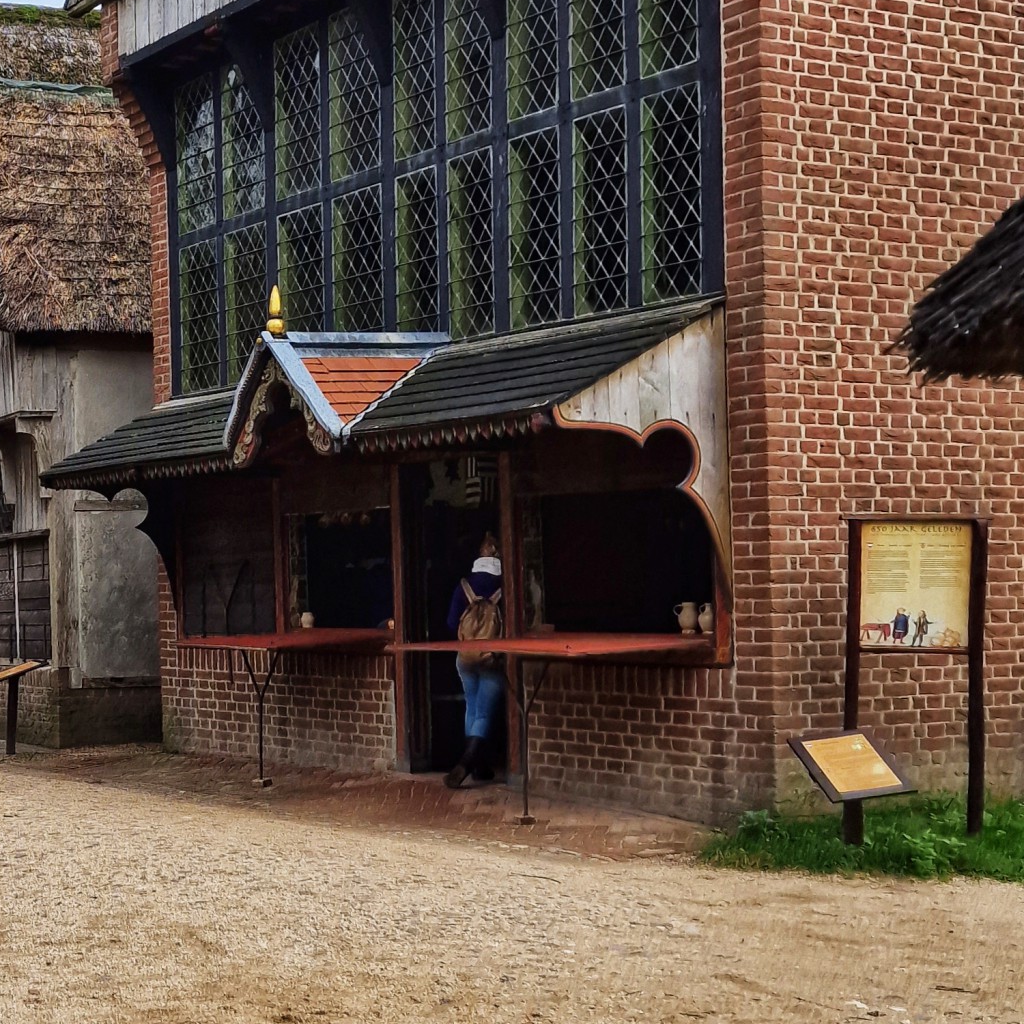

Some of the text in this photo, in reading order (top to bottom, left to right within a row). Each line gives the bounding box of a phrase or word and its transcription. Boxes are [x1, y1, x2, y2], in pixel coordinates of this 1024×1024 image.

[870, 525, 962, 533] 650 JAAR GELEDEN
